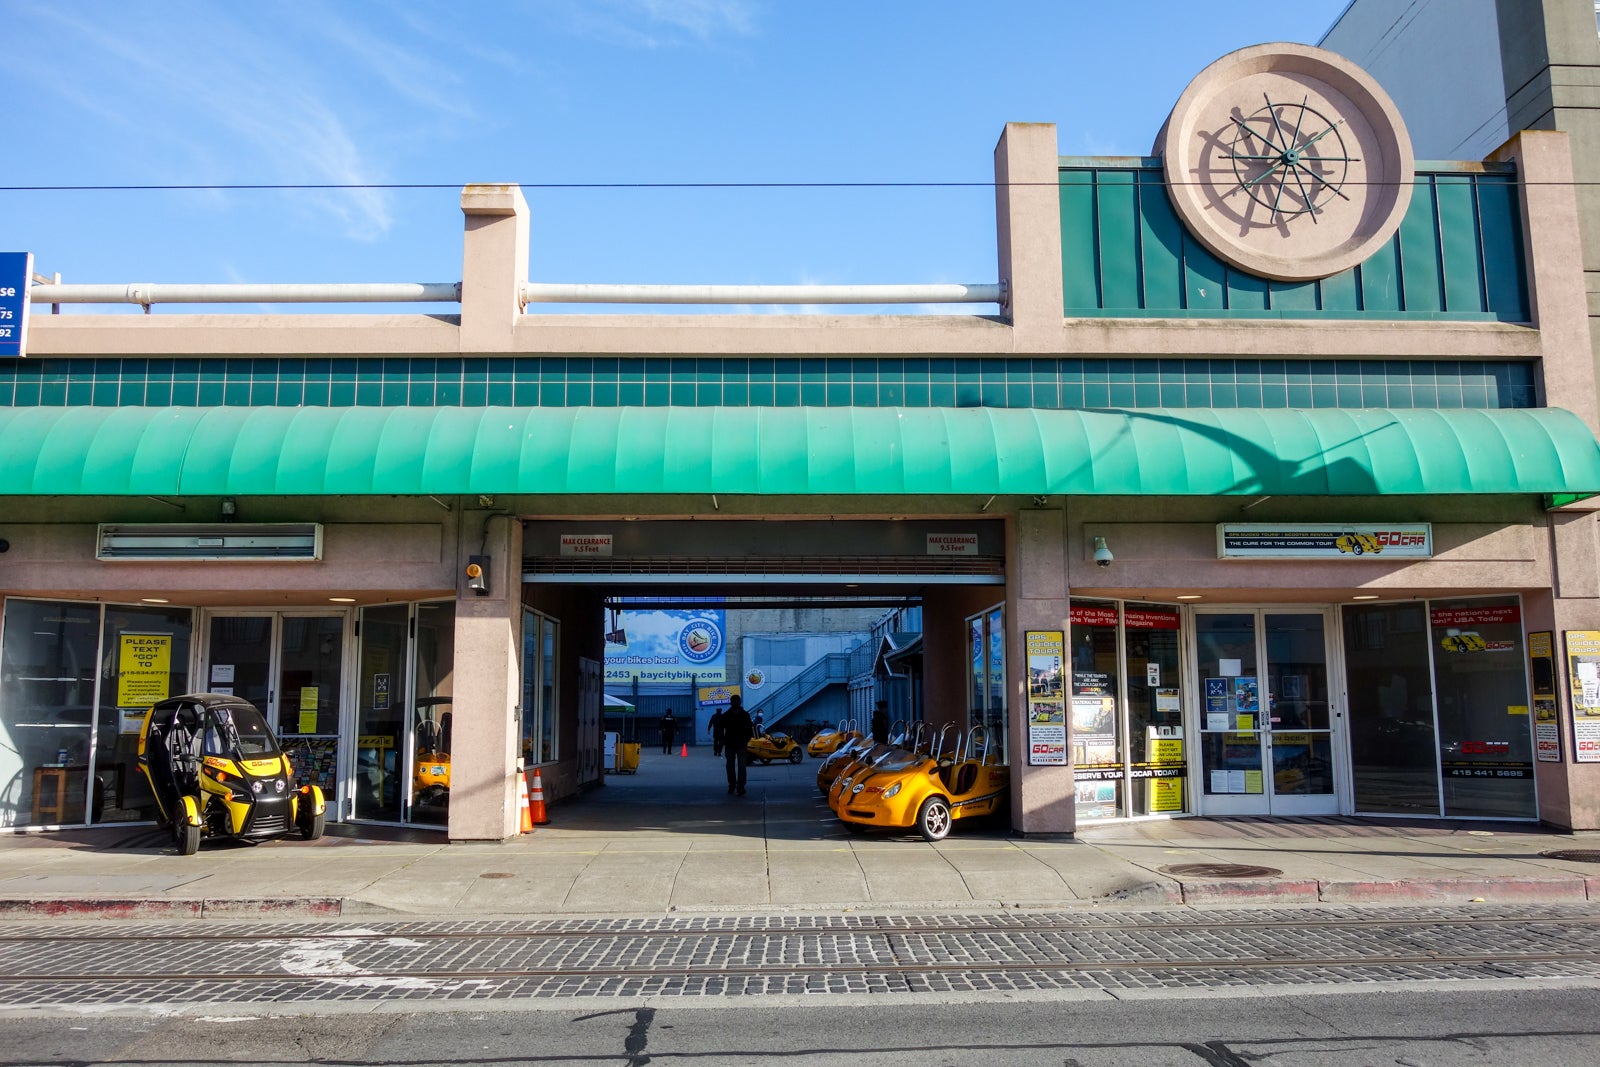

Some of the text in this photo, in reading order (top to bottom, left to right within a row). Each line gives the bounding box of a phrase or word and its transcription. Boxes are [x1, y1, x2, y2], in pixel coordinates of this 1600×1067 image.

[1455, 609, 1490, 617] nation's
[1125, 619, 1154, 627] Magazine
[604, 656, 679, 665] your bikes here!
[640, 670, 722, 680] baycitybike.com
[1073, 771, 1102, 779] ESERVE
[1153, 769, 1179, 777] TODAY!
